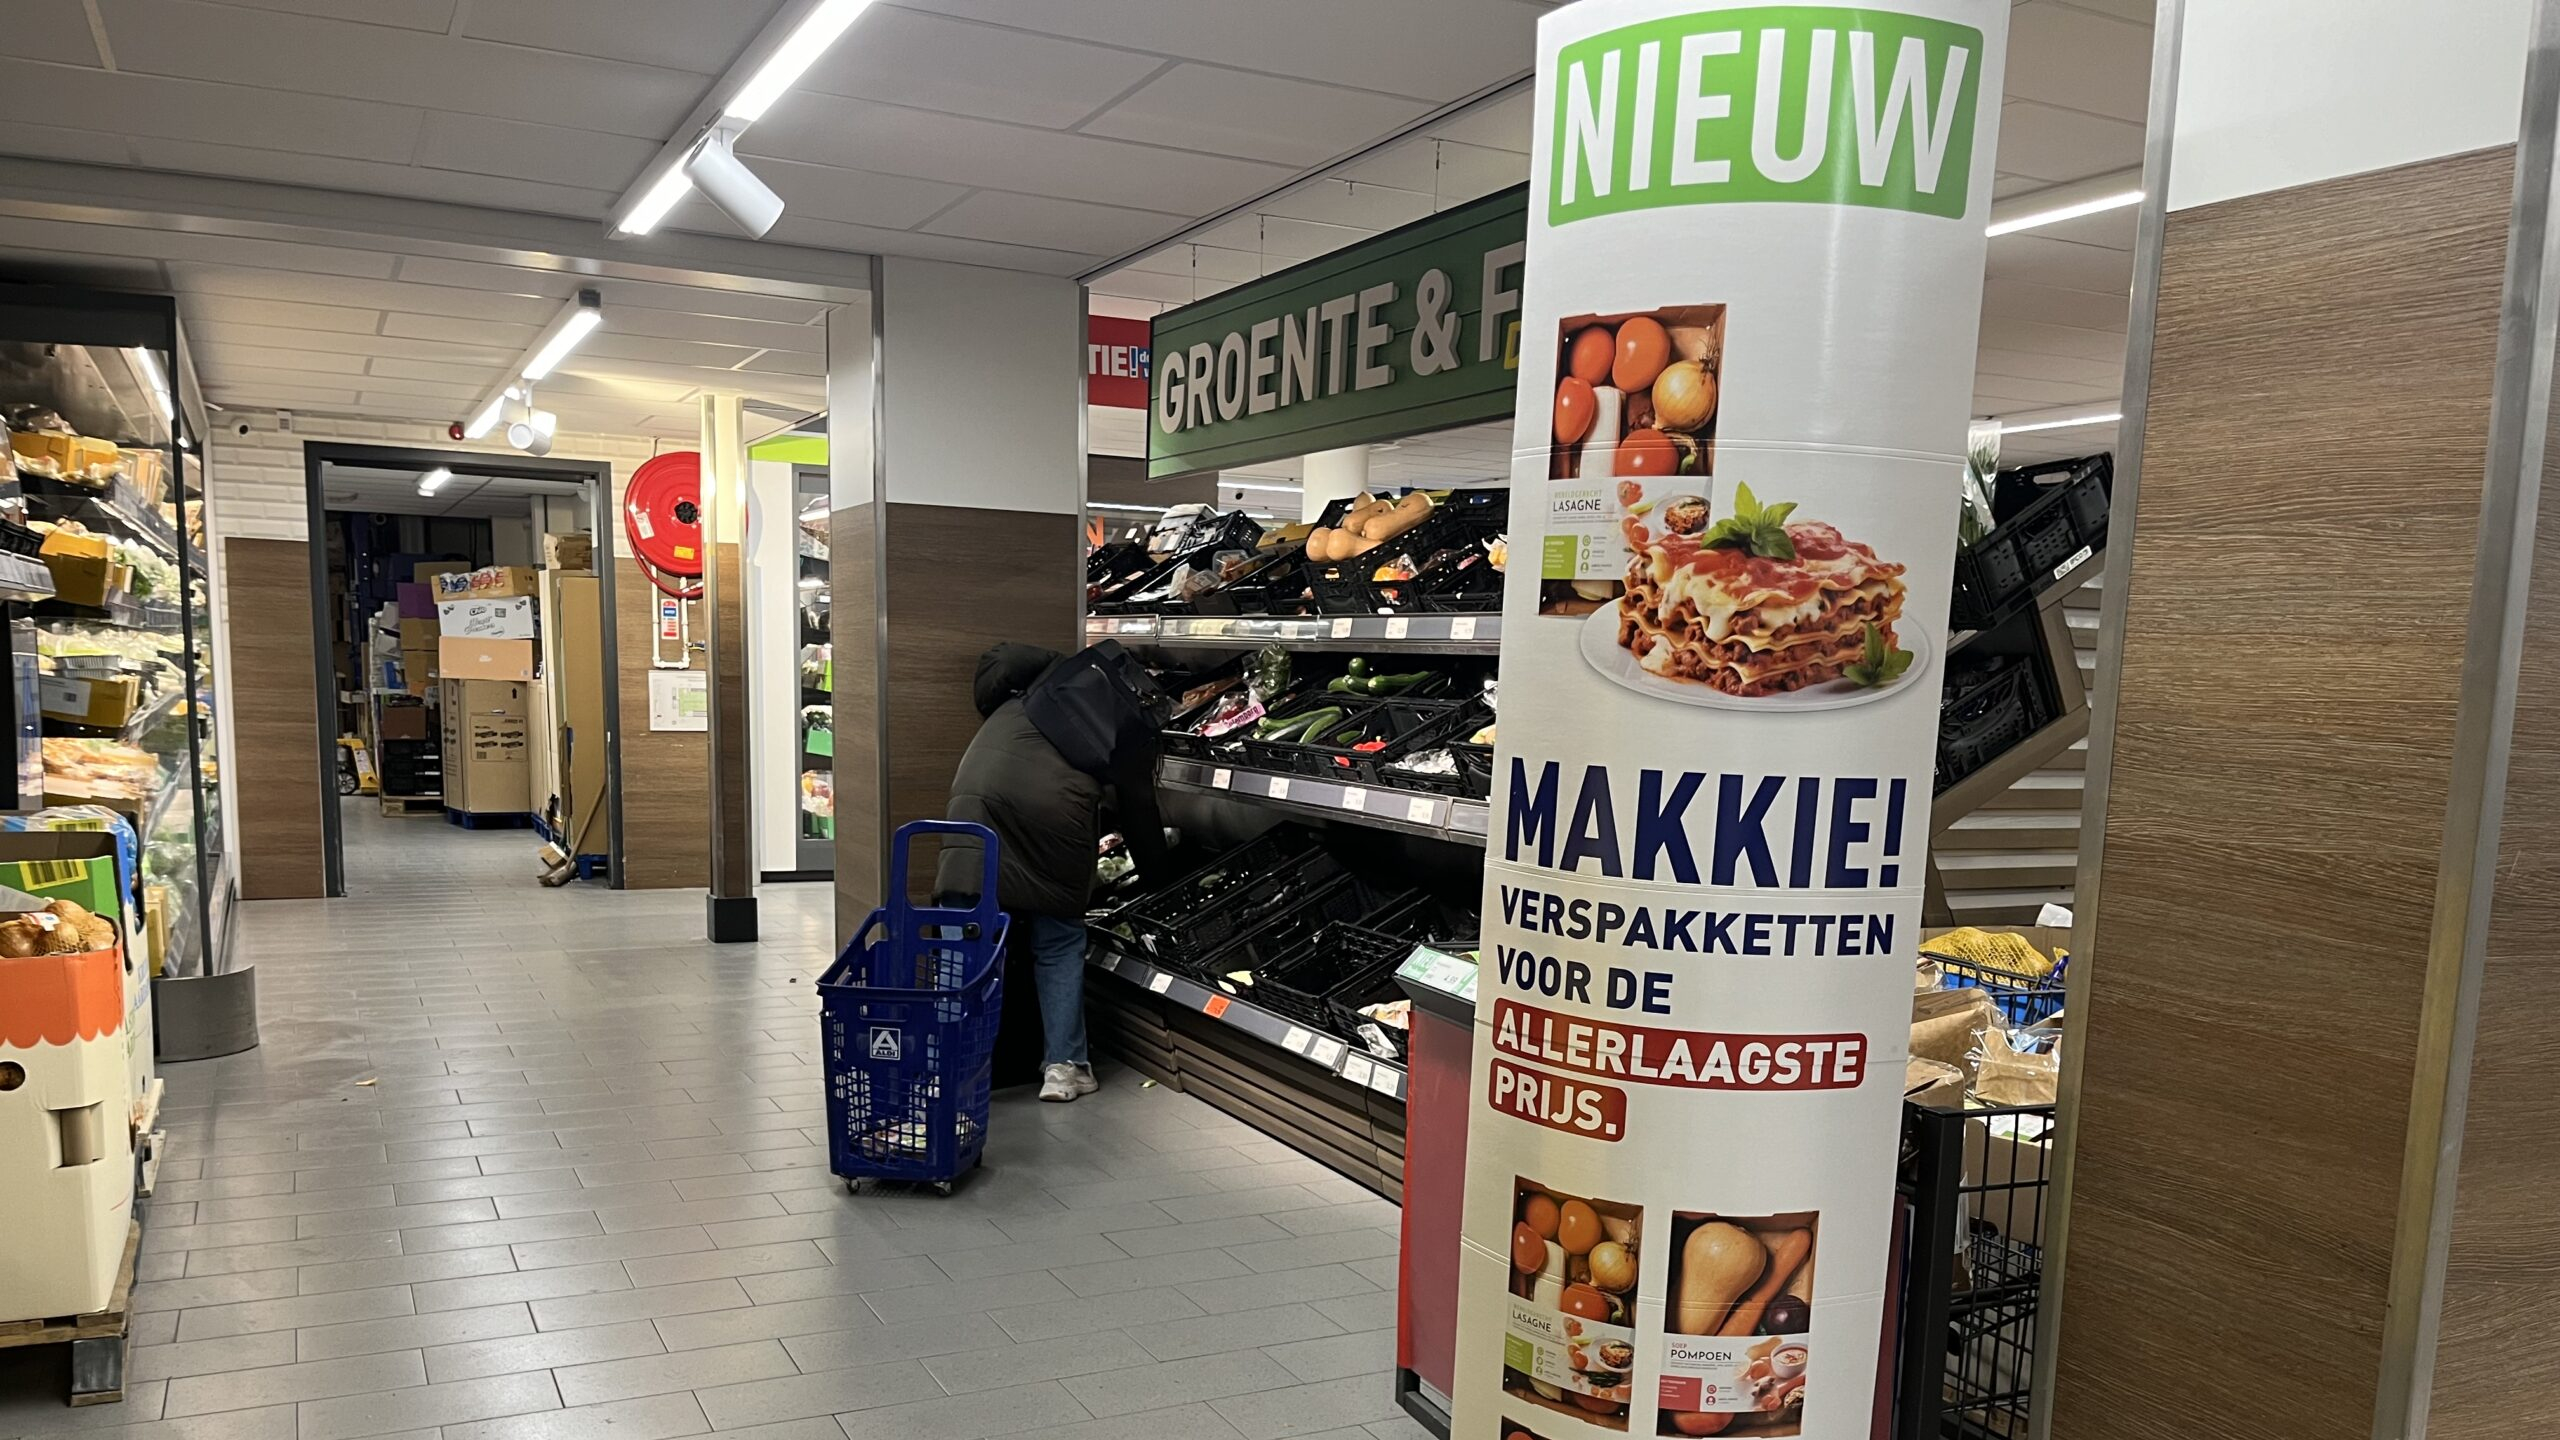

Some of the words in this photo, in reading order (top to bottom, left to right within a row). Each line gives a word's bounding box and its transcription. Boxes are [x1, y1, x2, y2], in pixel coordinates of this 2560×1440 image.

[1561, 28, 1969, 206] NIEUW
[1159, 281, 1397, 434] GROENTE
[1411, 268, 1461, 376] &
[1553, 499, 1601, 512] LASAGNE
[1505, 757, 1907, 888] MAKKIE!
[1500, 884, 1895, 956] VERSPAKKETTEN
[1497, 944, 1592, 1005] VOOR
[1606, 967, 1674, 1015] DE
[1496, 1007, 1862, 1085] ALLERLAAGSTE
[1495, 1064, 1618, 1136] PRIJS.
[1512, 1310, 1552, 1333] LASAGNE
[1670, 1349, 1732, 1361] POMPOEN
